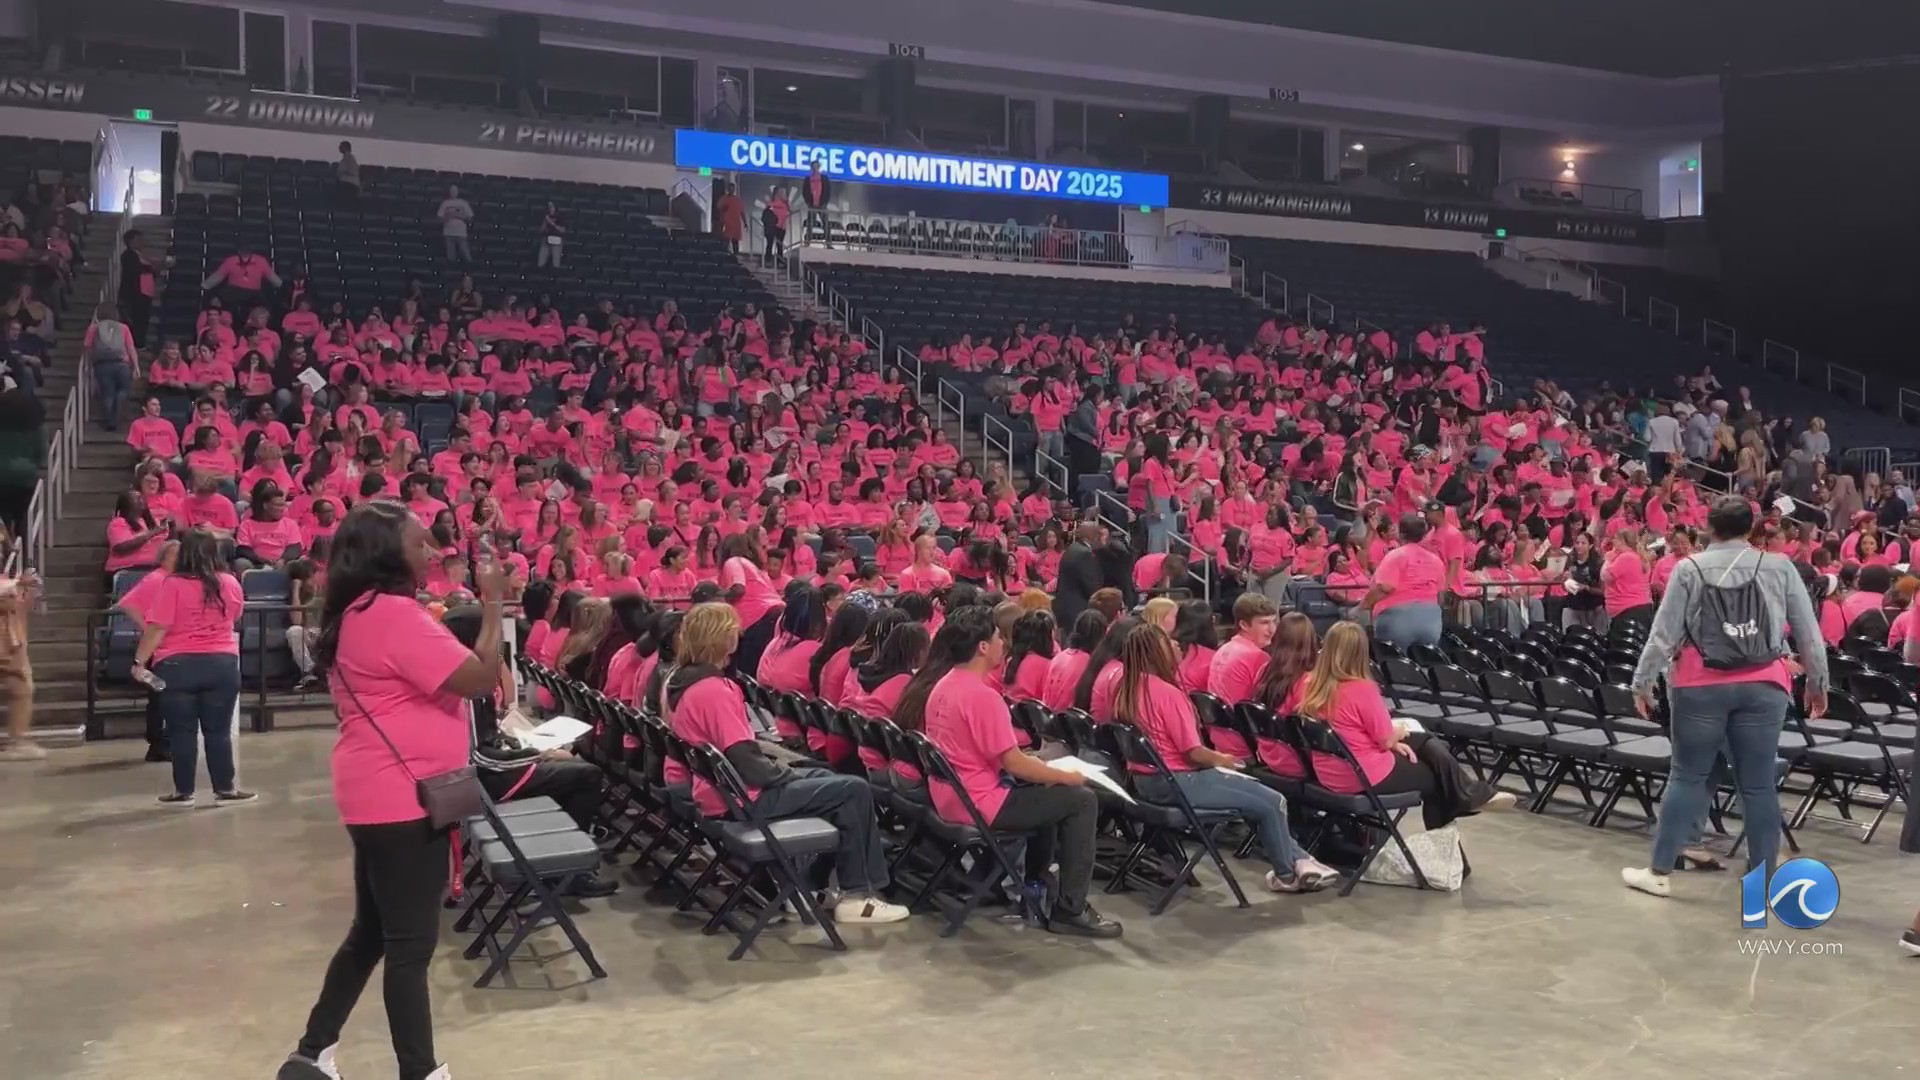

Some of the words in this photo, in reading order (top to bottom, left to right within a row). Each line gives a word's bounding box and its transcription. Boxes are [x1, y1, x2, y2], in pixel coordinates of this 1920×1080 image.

[894, 44, 920, 57] 104
[1274, 89, 1295, 101] 105
[205, 96, 240, 118] 22
[248, 99, 375, 130] DONOVAN
[478, 122, 505, 142] 21
[516, 124, 655, 155] PENICHEIRO
[731, 139, 845, 174] COLLEGE
[849, 149, 1016, 190] COMMITMENT
[1020, 166, 1063, 193] DAY
[1067, 170, 1123, 199] 2025
[1202, 189, 1221, 205] 33
[1227, 190, 1351, 216] MACHANGUANA
[1424, 208, 1439, 223] 13
[1443, 208, 1489, 226] DIXON
